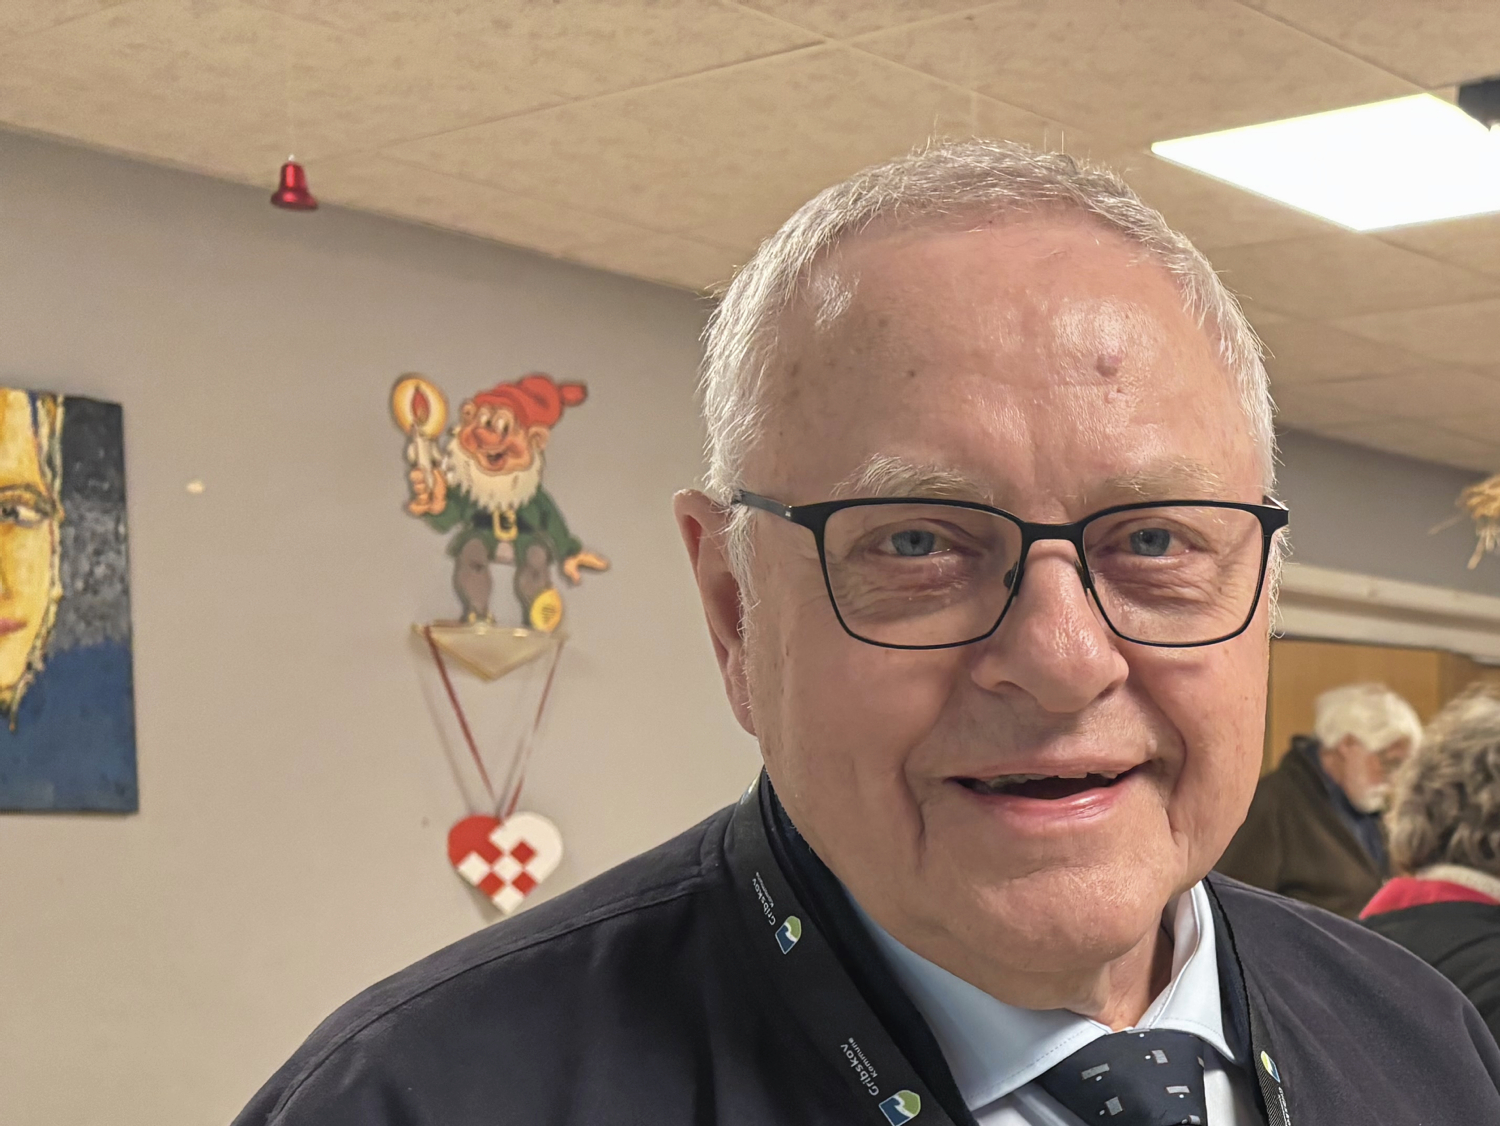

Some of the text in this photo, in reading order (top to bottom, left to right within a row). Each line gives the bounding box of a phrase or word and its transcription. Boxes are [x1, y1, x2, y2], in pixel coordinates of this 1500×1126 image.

[751, 877, 776, 926] Gribskov
[840, 1042, 880, 1096] Gribskov
[847, 1036, 878, 1078] Kommune
